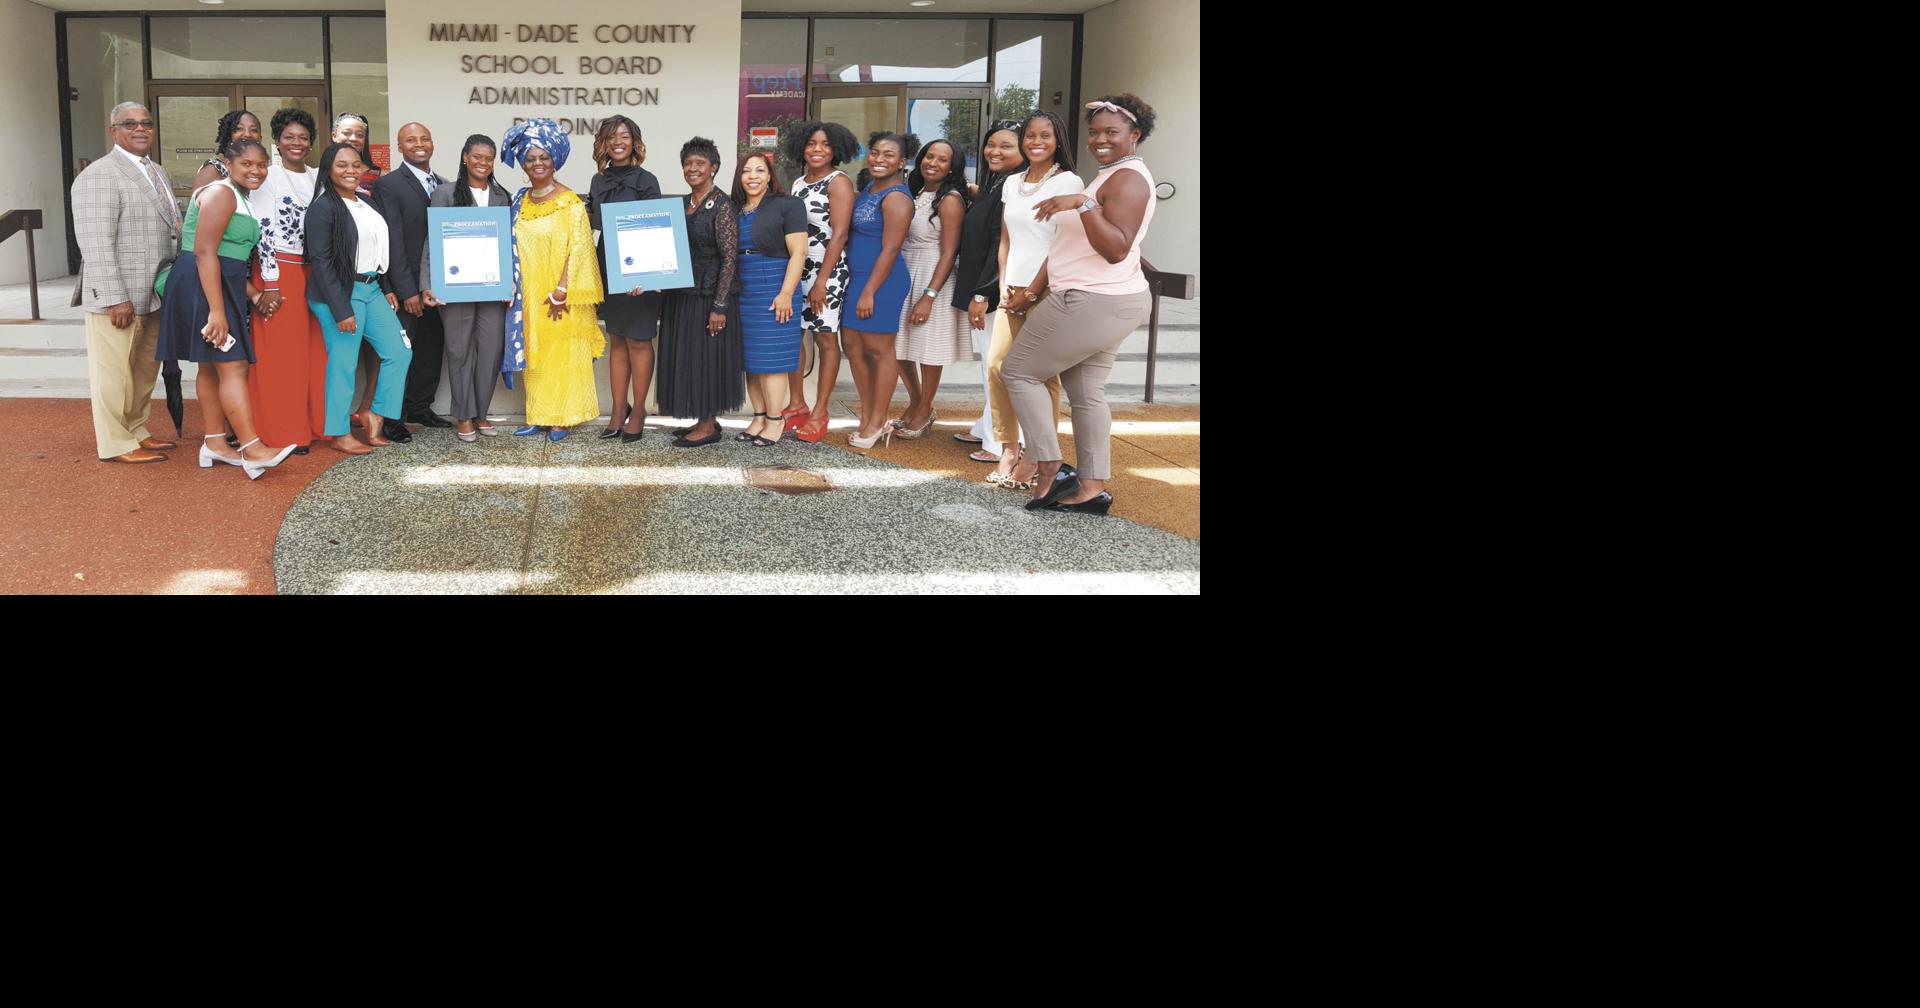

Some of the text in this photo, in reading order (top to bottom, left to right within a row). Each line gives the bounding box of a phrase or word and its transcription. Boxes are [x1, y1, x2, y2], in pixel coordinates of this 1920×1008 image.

[594, 24, 696, 44] COUNTY
[460, 54, 662, 75] SCHOOL BOARD
[468, 86, 659, 106] ADMINISTRATION
